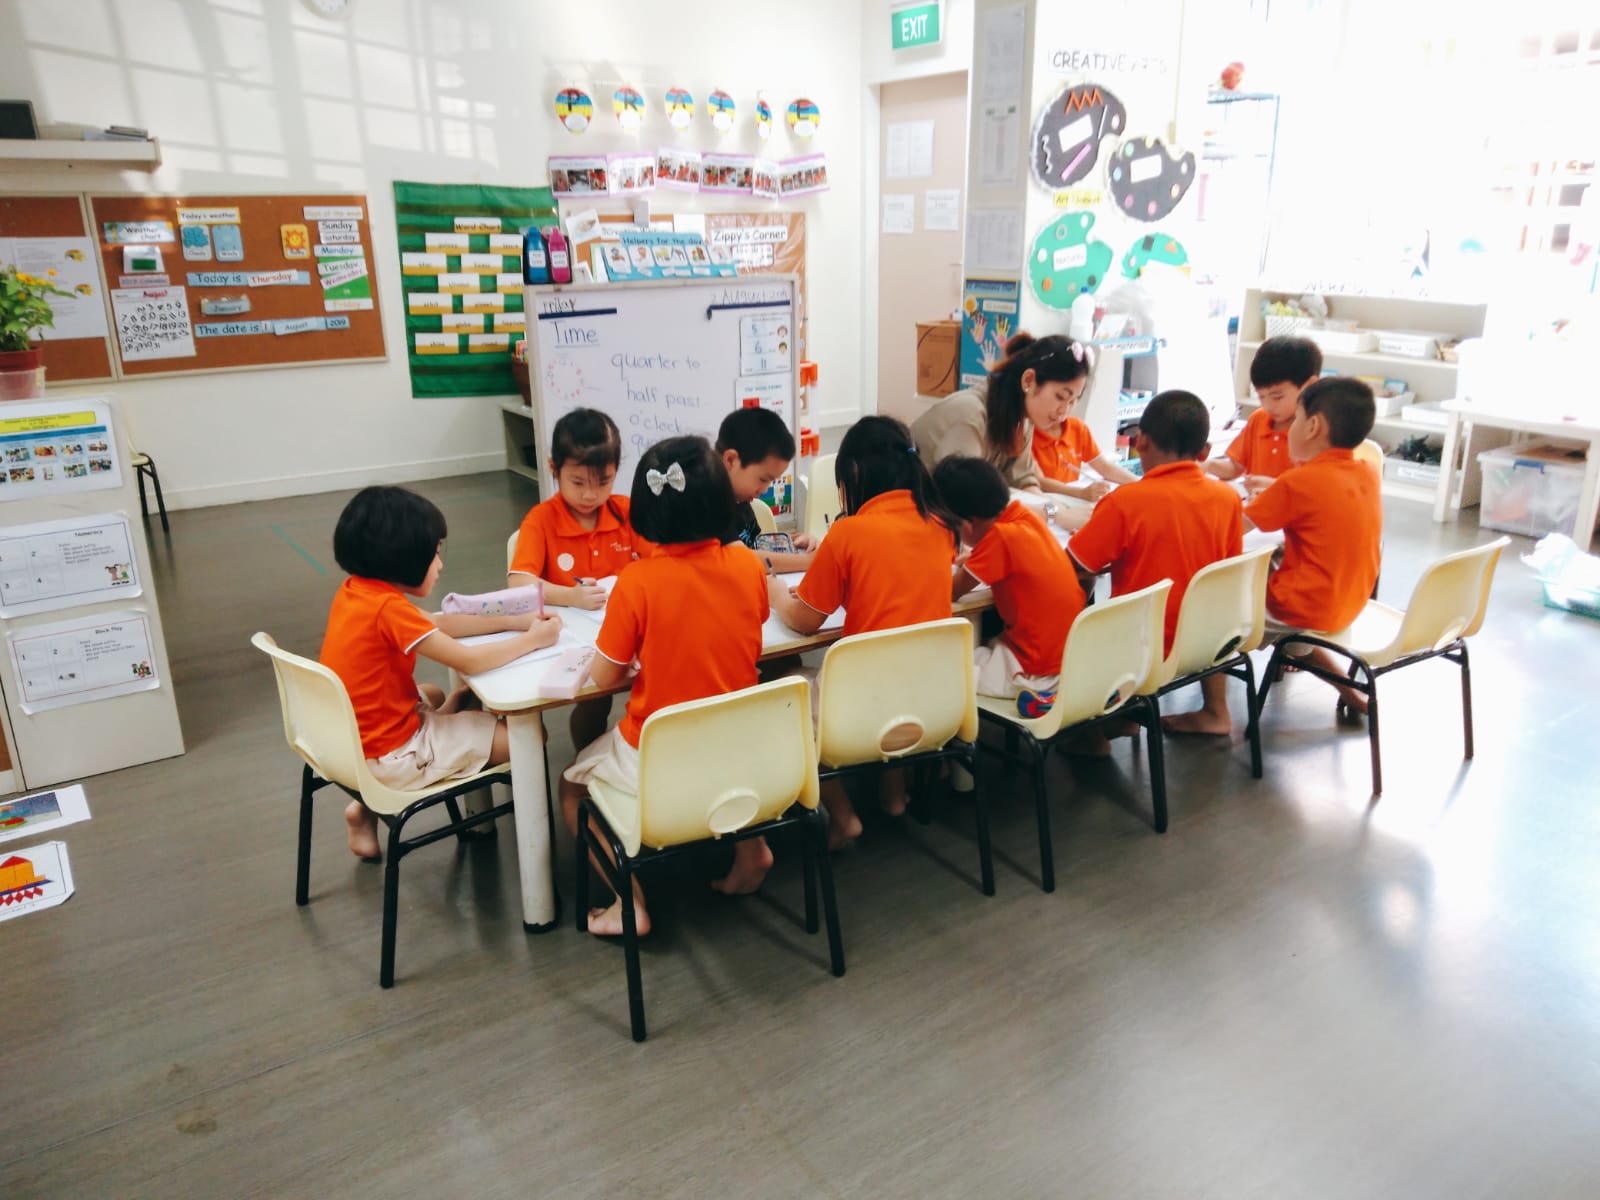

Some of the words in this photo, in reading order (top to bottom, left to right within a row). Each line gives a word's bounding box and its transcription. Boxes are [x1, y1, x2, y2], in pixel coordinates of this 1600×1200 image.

[902, 14, 928, 42] EXIT
[1052, 50, 1127, 72] CREATIVE
[321, 221, 353, 232] Sunday
[622, 236, 654, 247] Helpers
[656, 236, 669, 246] for
[714, 229, 750, 243] Zippy's
[753, 229, 786, 241] Corner
[320, 246, 354, 255] Monday
[323, 261, 359, 272] Tuesday
[196, 273, 229, 286] Today
[232, 273, 242, 283] is
[198, 325, 223, 336] The
[225, 324, 247, 335] date
[250, 323, 260, 333] is
[550, 320, 598, 344] Time
[611, 352, 680, 381] quarter
[687, 355, 701, 369] to
[626, 381, 658, 402] half
[665, 393, 700, 409] past
